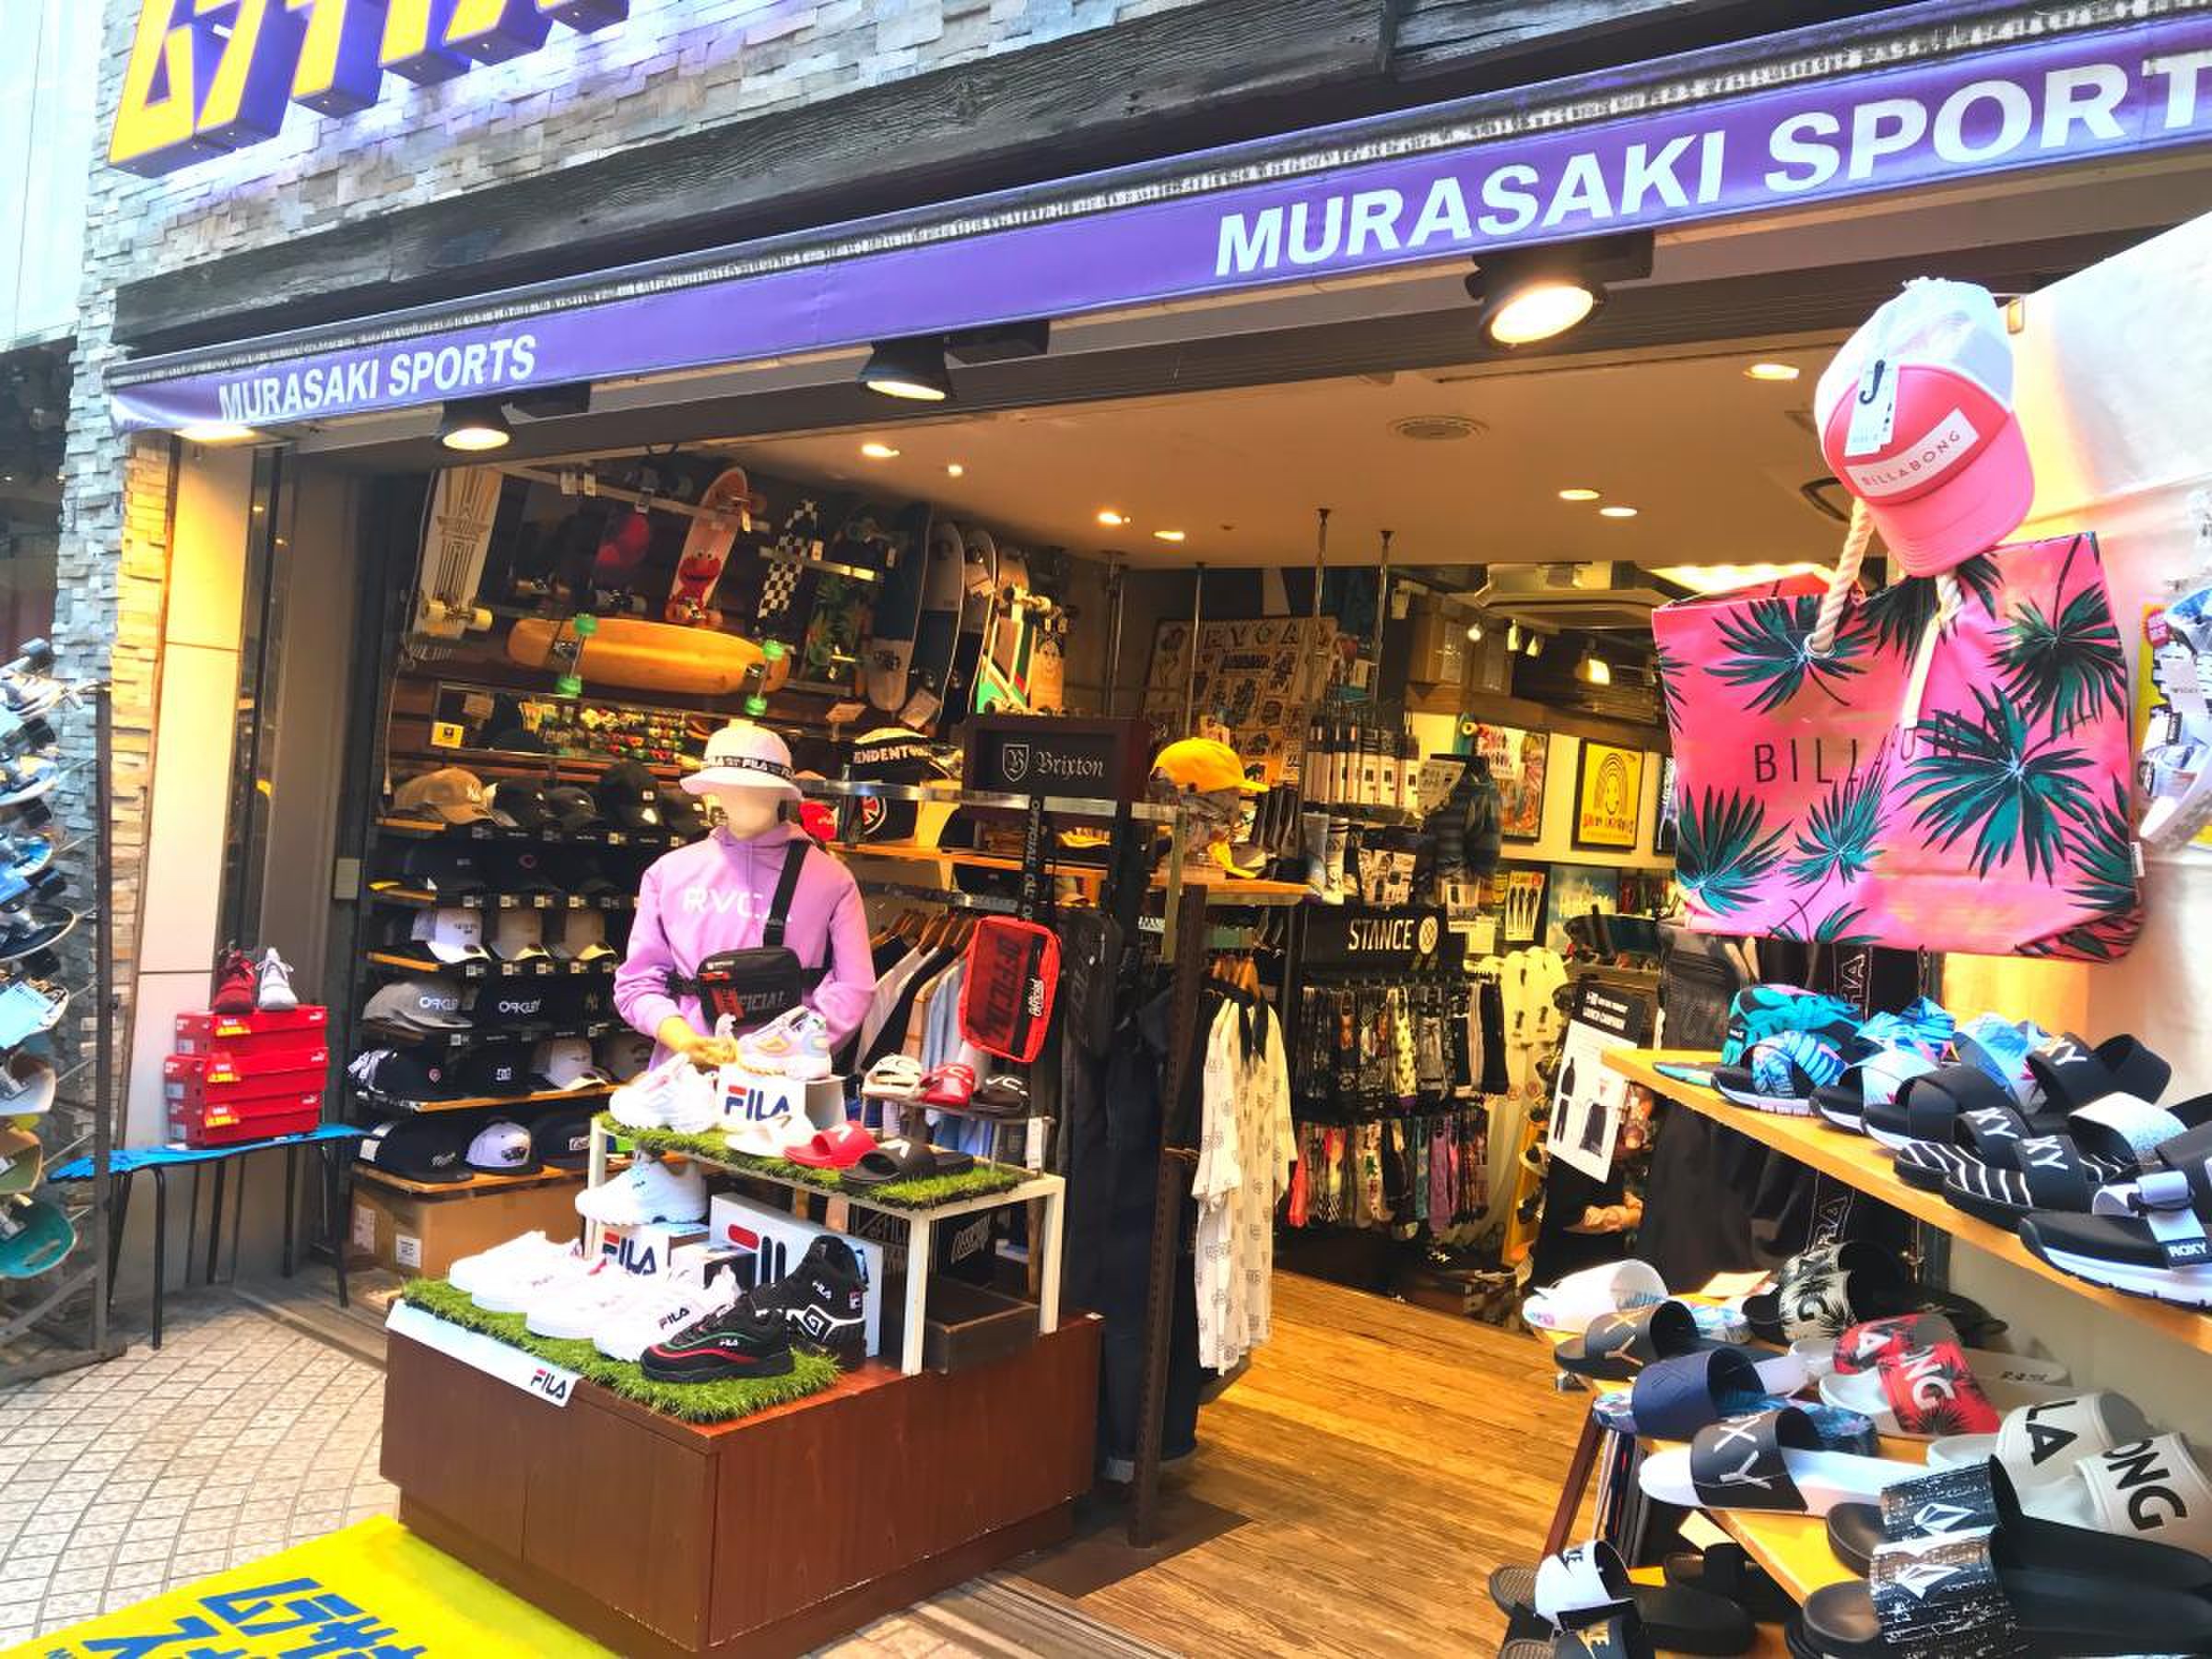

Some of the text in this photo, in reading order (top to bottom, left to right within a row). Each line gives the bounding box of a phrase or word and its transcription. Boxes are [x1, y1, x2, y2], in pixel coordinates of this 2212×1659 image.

[1214, 130, 1725, 278] MURASAKI
[218, 334, 537, 424] MURASAKI SPORTS
[1861, 429, 1961, 487] BILLABONG
[1037, 751, 1105, 780] Brixton
[682, 884, 793, 923] RVC
[1347, 919, 1415, 952] STANCE
[724, 1084, 791, 1122] FILA
[600, 1229, 657, 1276] FILA
[2167, 1241, 2207, 1258] ROXY
[658, 1306, 690, 1331] FILA
[530, 1368, 567, 1400] FILA
